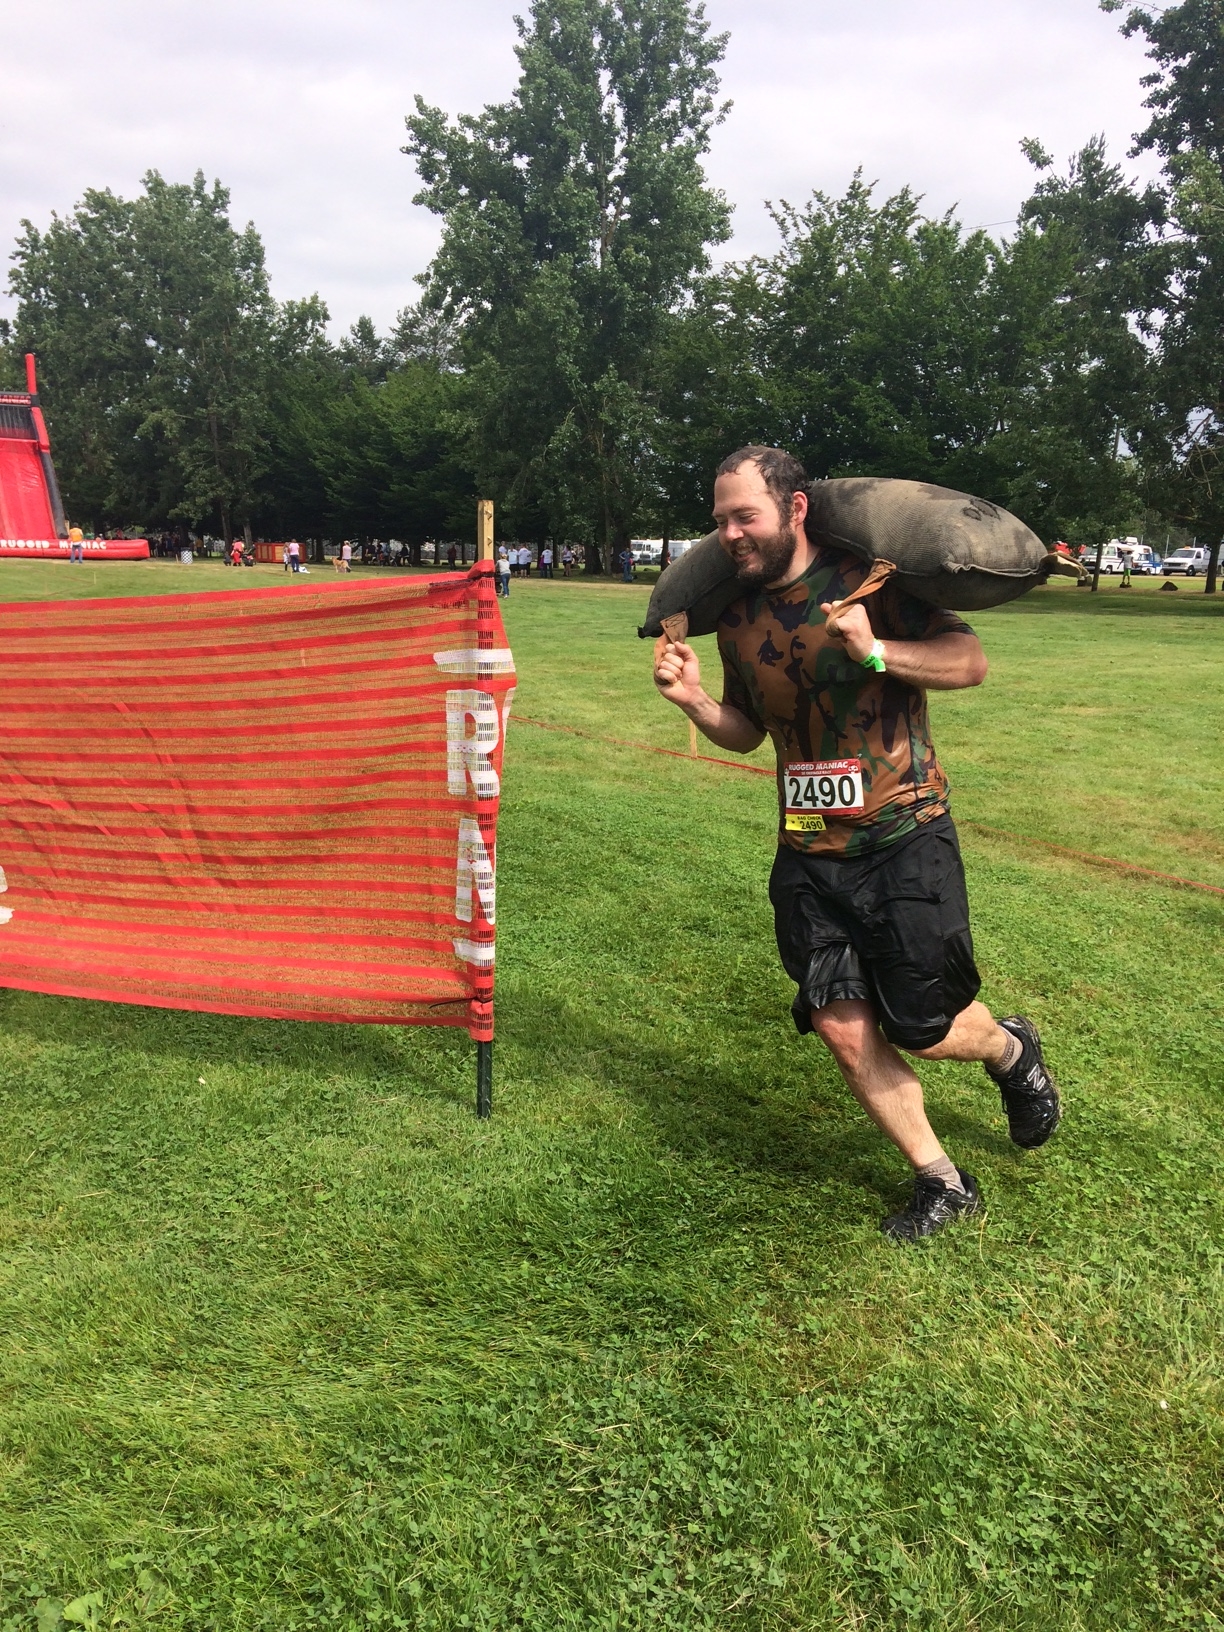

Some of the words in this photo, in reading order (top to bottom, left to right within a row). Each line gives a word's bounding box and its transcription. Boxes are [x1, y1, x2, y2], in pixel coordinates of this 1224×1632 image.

[0, 539, 50, 549] RUGGED
[59, 540, 107, 549] MNIAC
[816, 761, 848, 770] MANIAC
[789, 775, 856, 807] 2490
[800, 820, 822, 830] 2490
